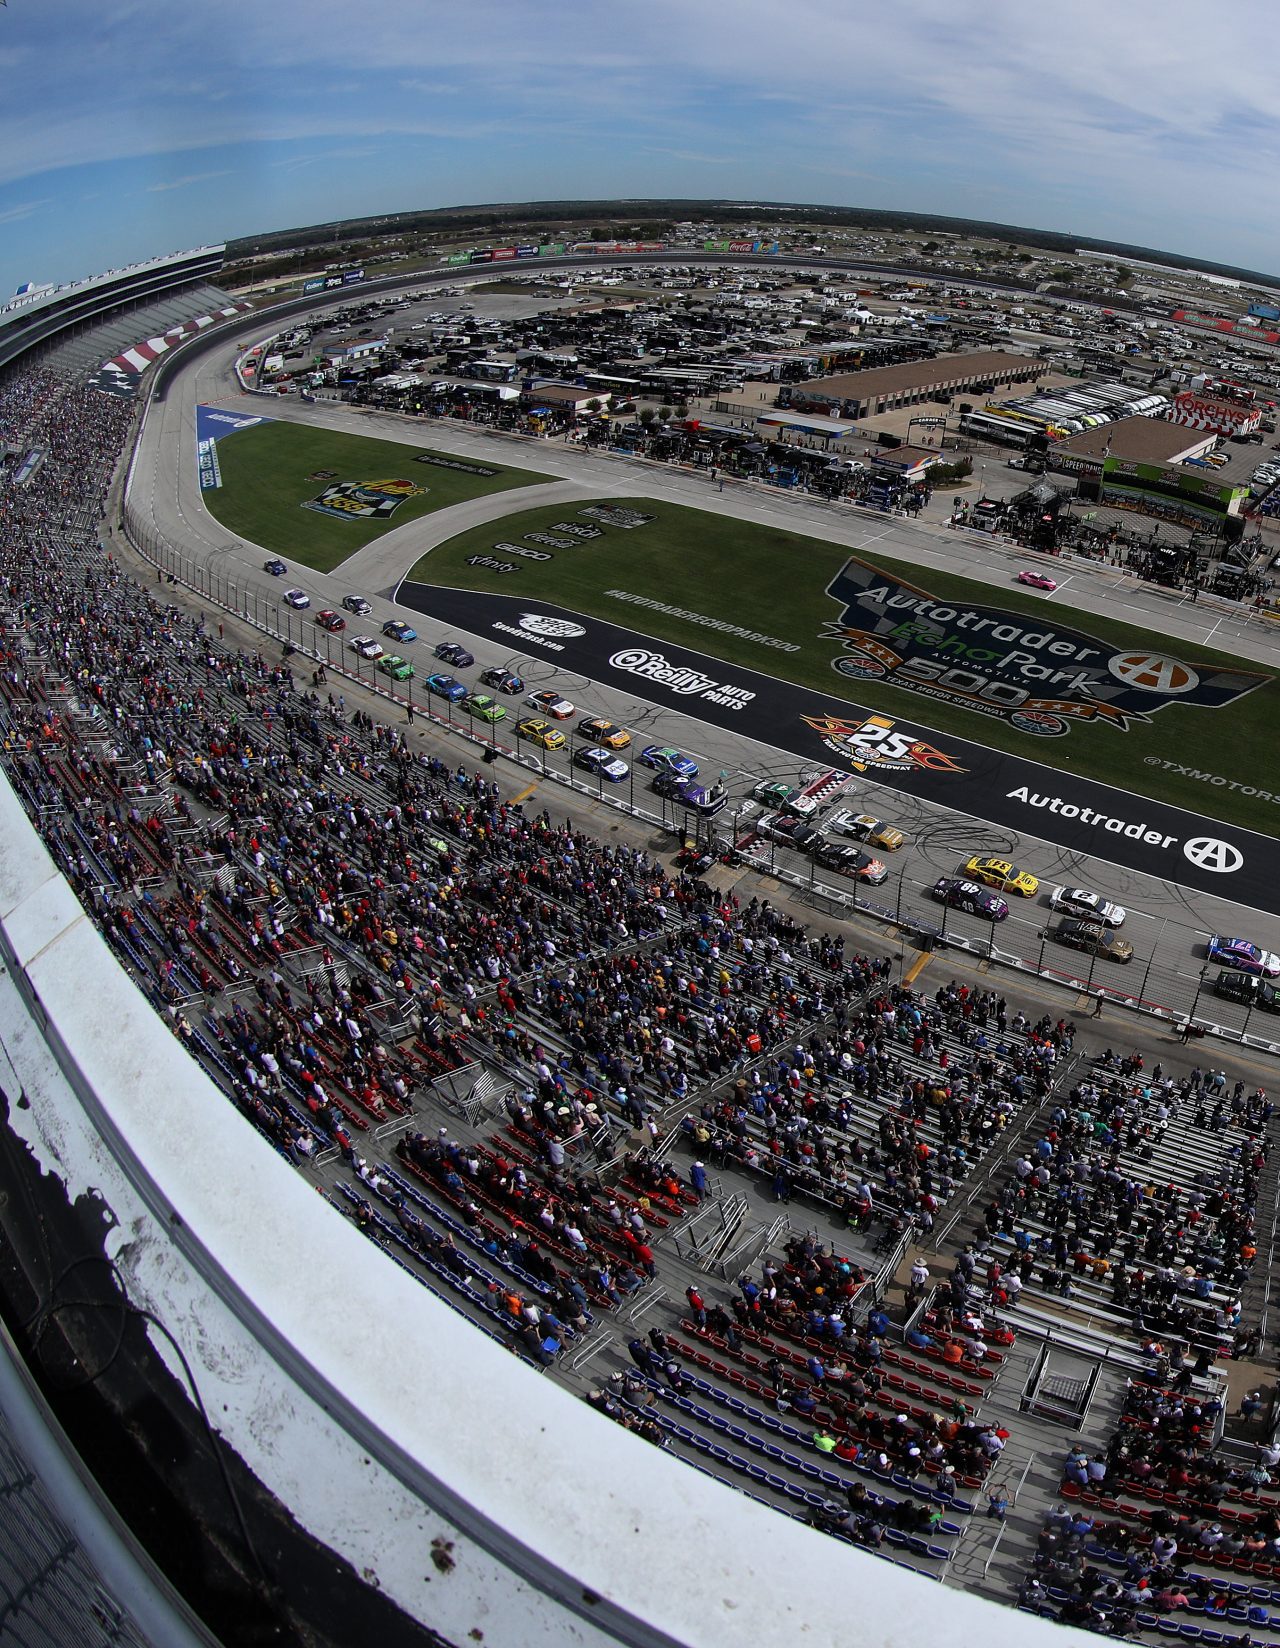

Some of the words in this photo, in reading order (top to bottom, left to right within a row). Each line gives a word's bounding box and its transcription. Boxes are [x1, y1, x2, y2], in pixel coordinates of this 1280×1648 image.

[551, 523, 601, 538] BUSCH
[468, 555, 520, 573] xfinity
[495, 543, 551, 560] GEICO
[492, 621, 565, 651] SpeedyCash.com
[603, 589, 802, 653] #AUTOTRADERECHOPARK500
[855, 585, 1100, 661] Autotrader
[609, 648, 719, 694] O'Reilly
[895, 656, 1030, 706] 500
[932, 652, 1030, 685] AUTOMOTIVE
[701, 689, 747, 711] PARTS
[719, 684, 756, 700] AUTO
[886, 675, 917, 692] TEXAS
[916, 683, 952, 702] MOTOR
[953, 692, 1007, 716] SPEEDWAY
[822, 738, 839, 753] TEXAS
[839, 749, 864, 764] MOTOR
[865, 759, 911, 771] SPEEDWAY
[846, 724, 919, 758] 25
[1006, 786, 1178, 851] Autotrader
[992, 861, 1006, 869] 34
[961, 882, 980, 894] 48
[1078, 890, 1092, 899] 2
[961, 900, 975, 912] 48
